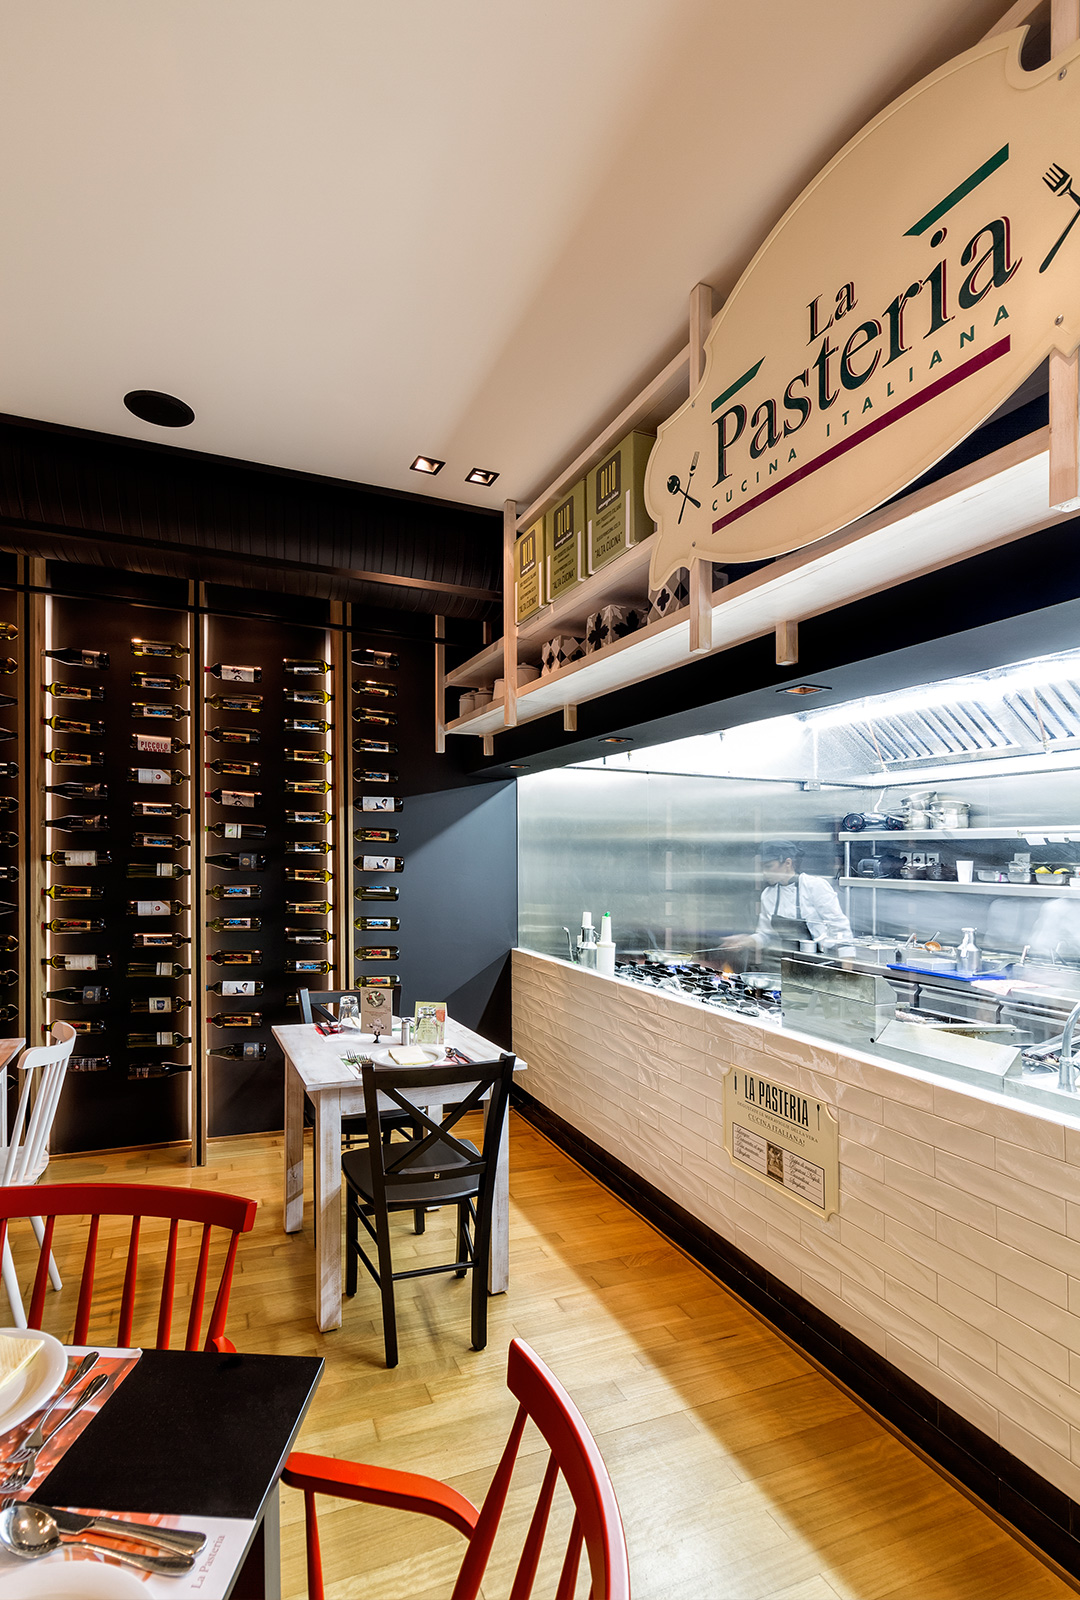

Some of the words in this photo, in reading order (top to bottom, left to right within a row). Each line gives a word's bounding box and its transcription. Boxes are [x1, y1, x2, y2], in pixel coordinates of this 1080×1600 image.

[806, 281, 858, 346] La
[712, 216, 1022, 488] Pasteria
[712, 449, 797, 511] CUCINA
[826, 305, 1009, 437] ITALIANA
[140, 741, 168, 750] PICCOLO
[745, 1075, 755, 1102] LA
[759, 1080, 809, 1127] PASTERIA
[748, 1113, 771, 1130] CUCINA
[191, 1575, 206, 1589] La
[199, 1535, 225, 1573] Pasteria
